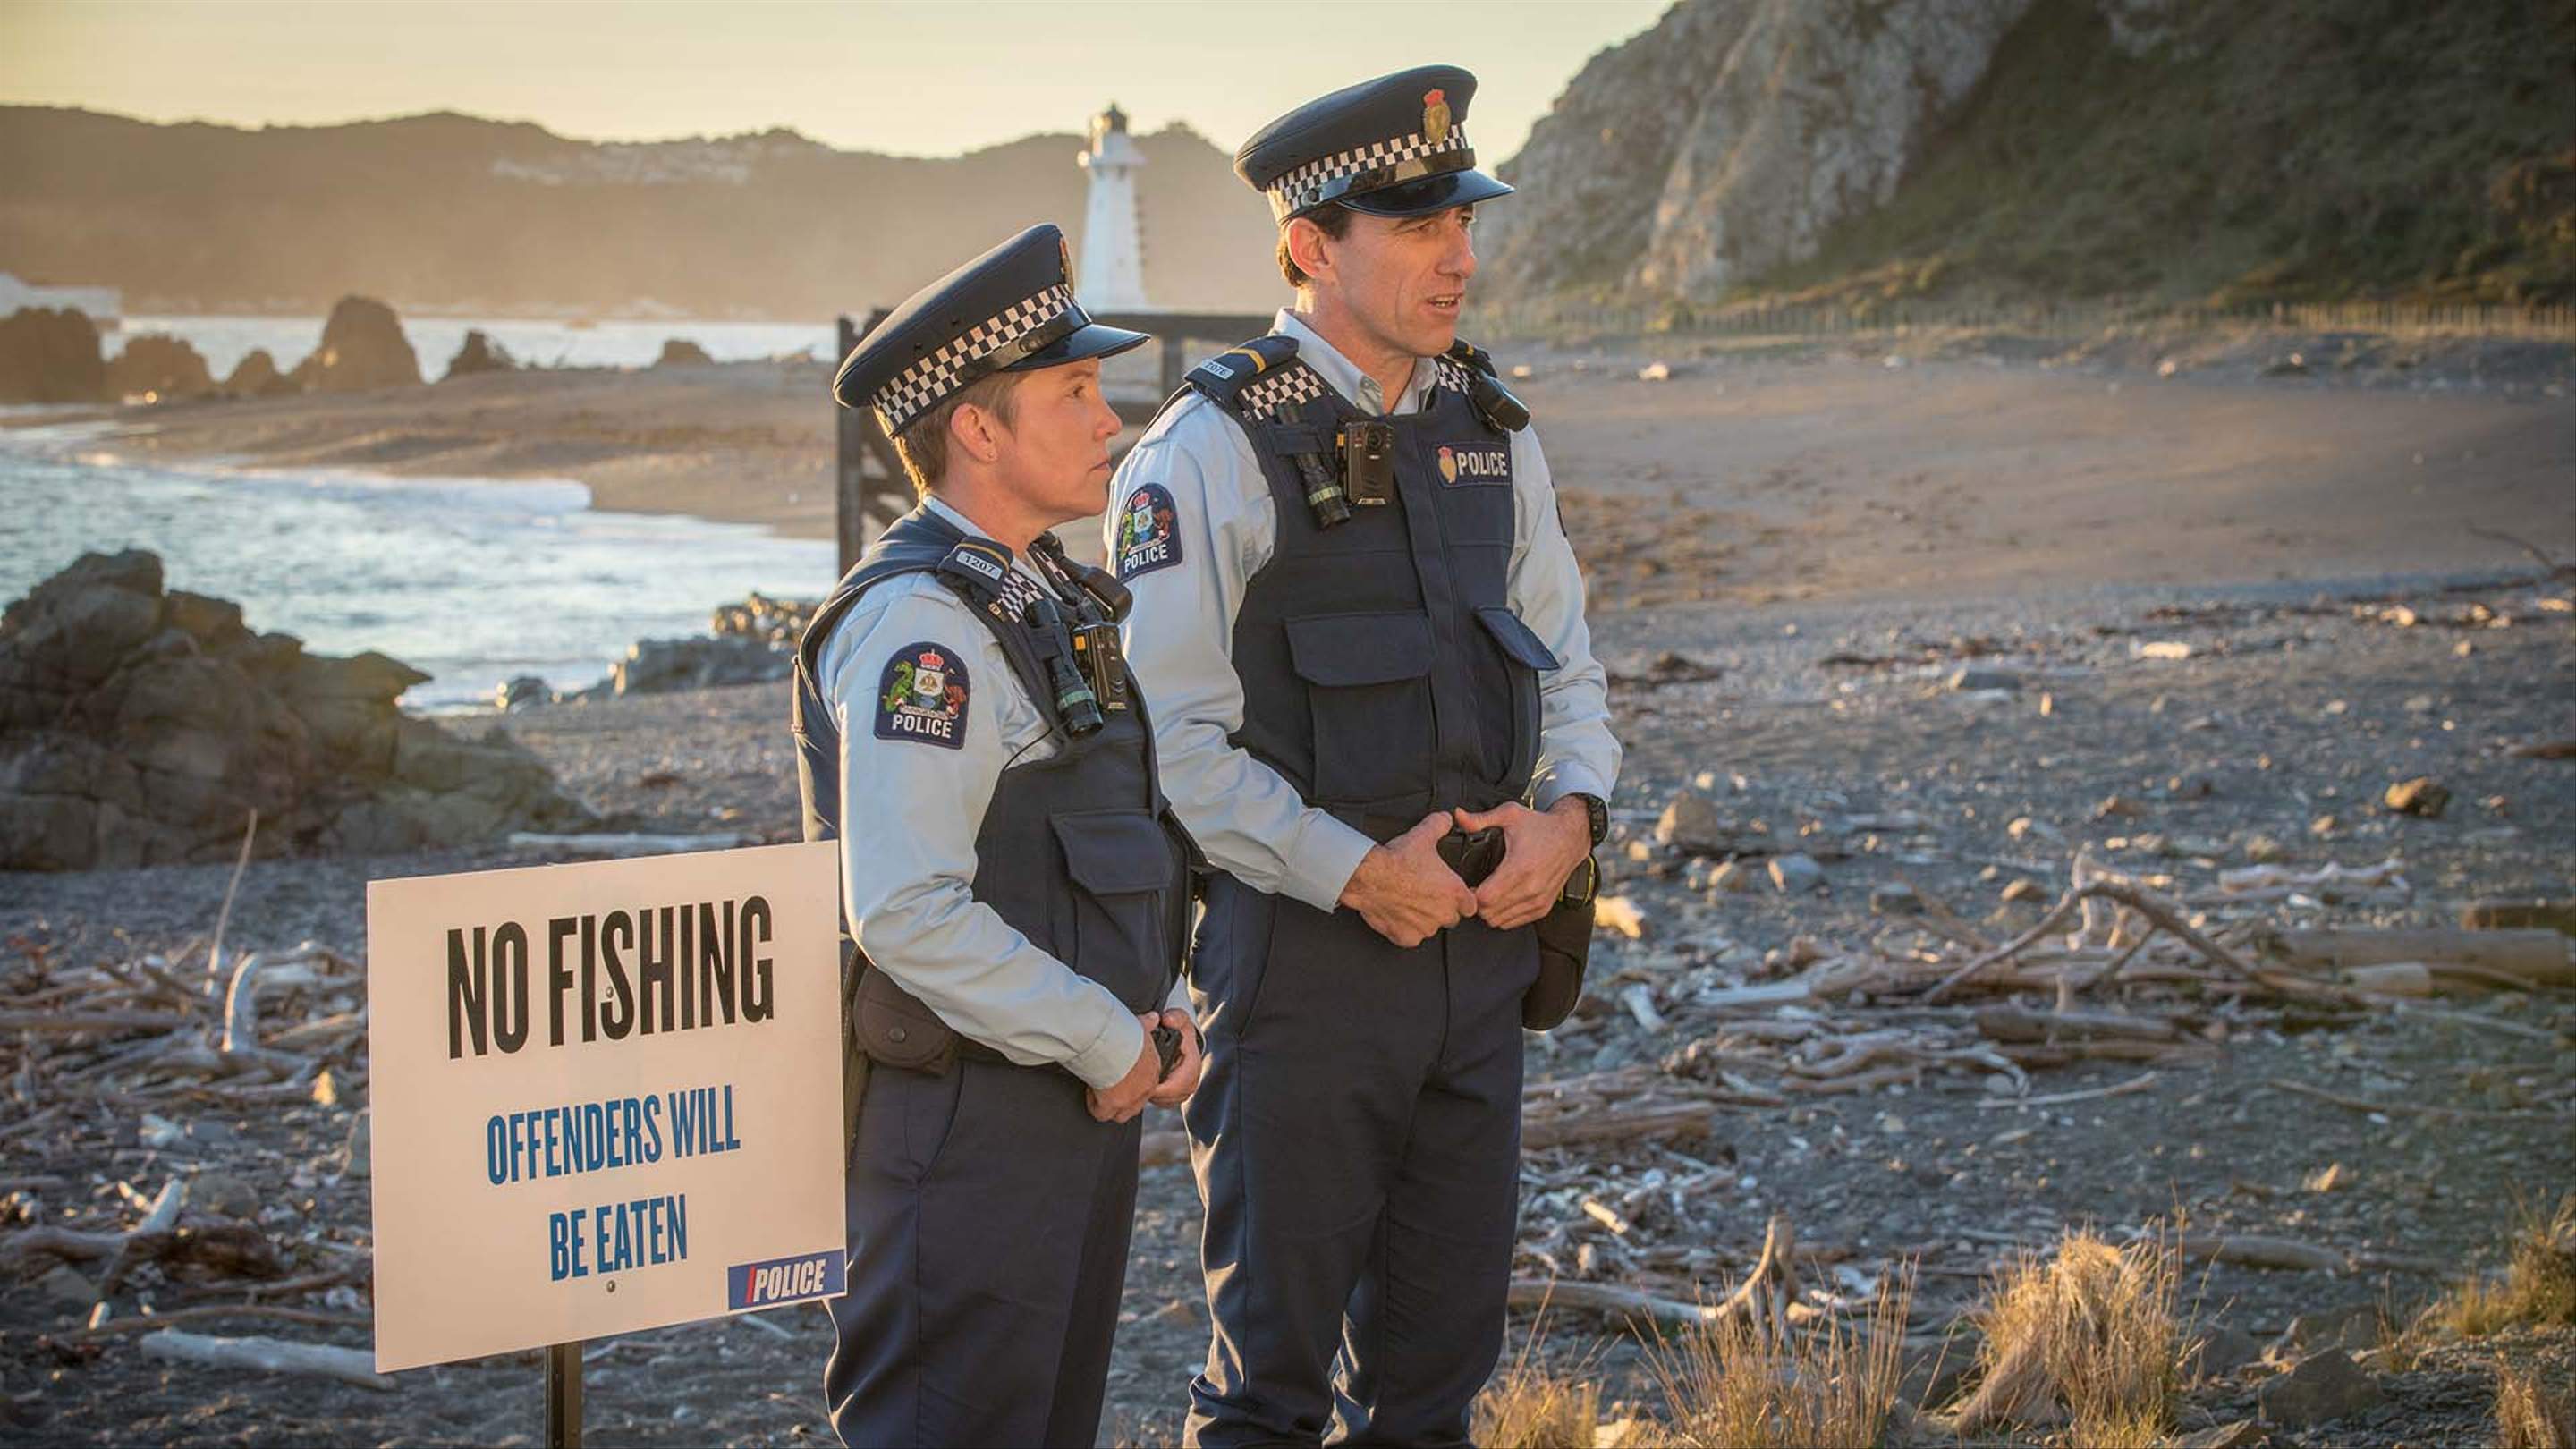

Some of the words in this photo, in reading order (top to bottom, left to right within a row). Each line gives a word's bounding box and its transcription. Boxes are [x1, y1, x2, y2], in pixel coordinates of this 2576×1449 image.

[1456, 451, 1508, 476] POLICE
[965, 555, 996, 573] 1207
[1124, 543, 1168, 573] POLICE
[892, 714, 953, 739] POLICE
[447, 921, 530, 1059] NO
[548, 895, 775, 1046] FISHING
[487, 1094, 663, 1185] OFFENDERS
[668, 1084, 741, 1158] WILL
[549, 1209, 589, 1282] BE
[596, 1194, 688, 1277] EATEN
[753, 1258, 826, 1302] POLICE
